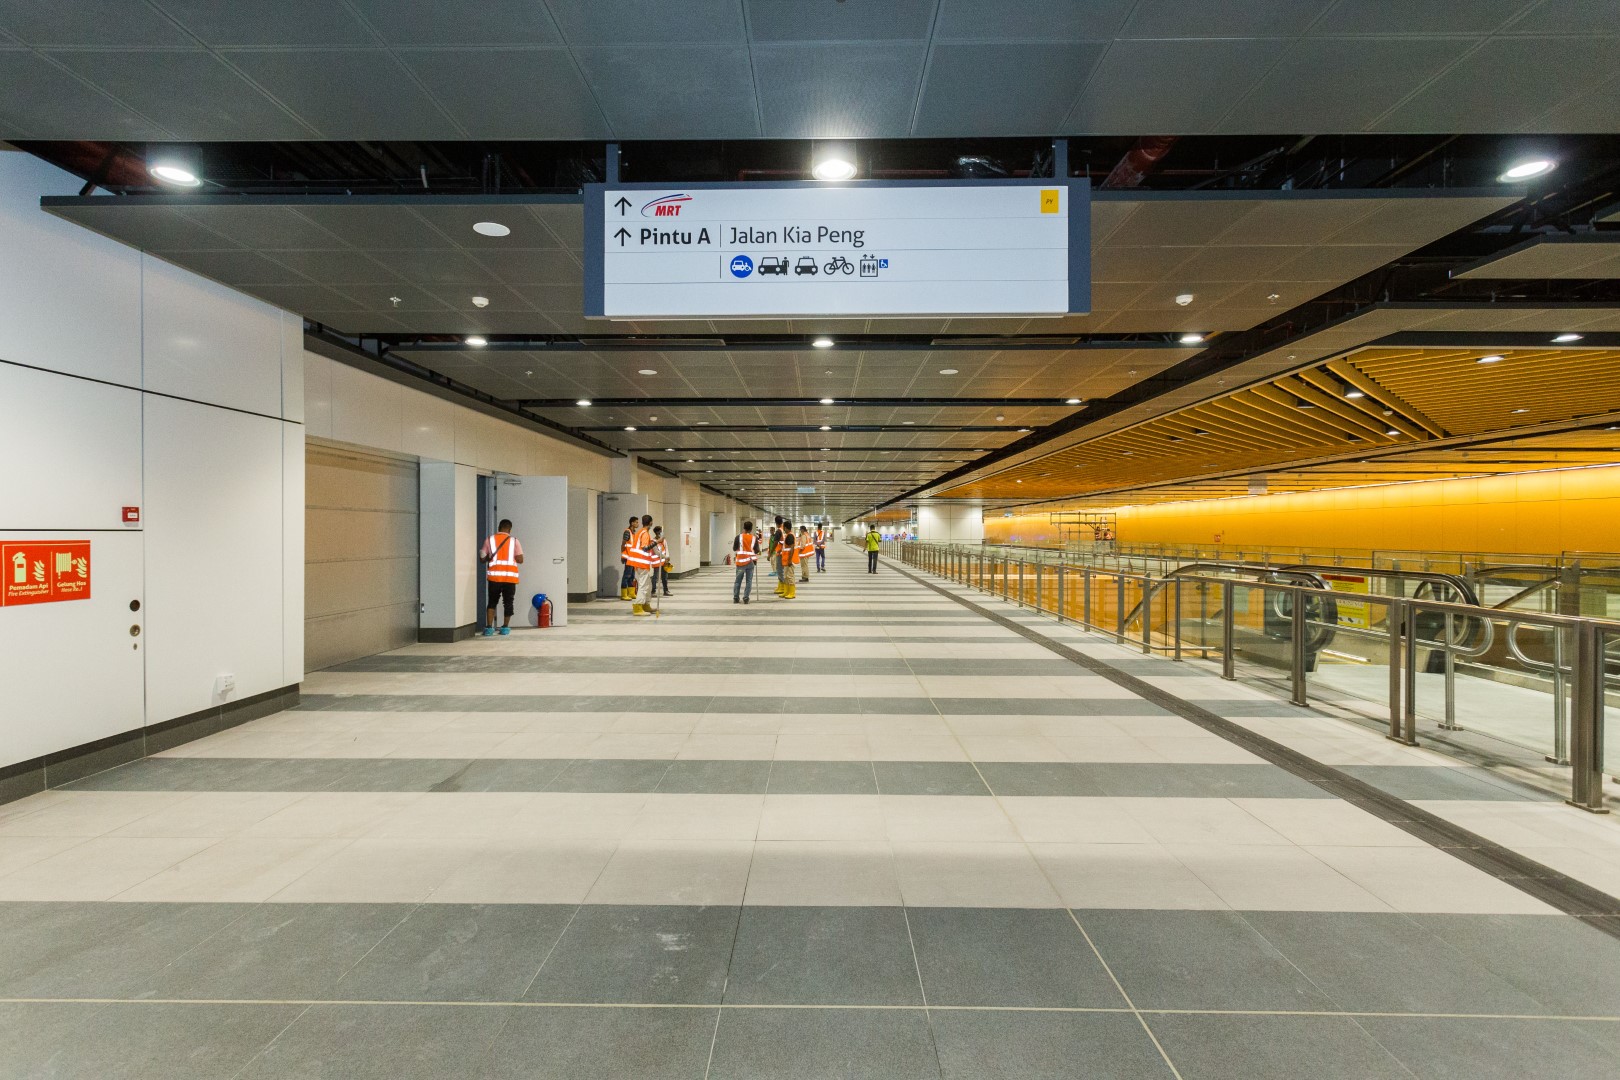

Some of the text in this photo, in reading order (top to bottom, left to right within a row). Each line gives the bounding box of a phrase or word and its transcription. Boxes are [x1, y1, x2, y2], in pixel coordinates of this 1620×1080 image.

[655, 205, 682, 217] MRT
[640, 227, 711, 245] Pintu A
[729, 226, 865, 248] Jalan Kia Peng
